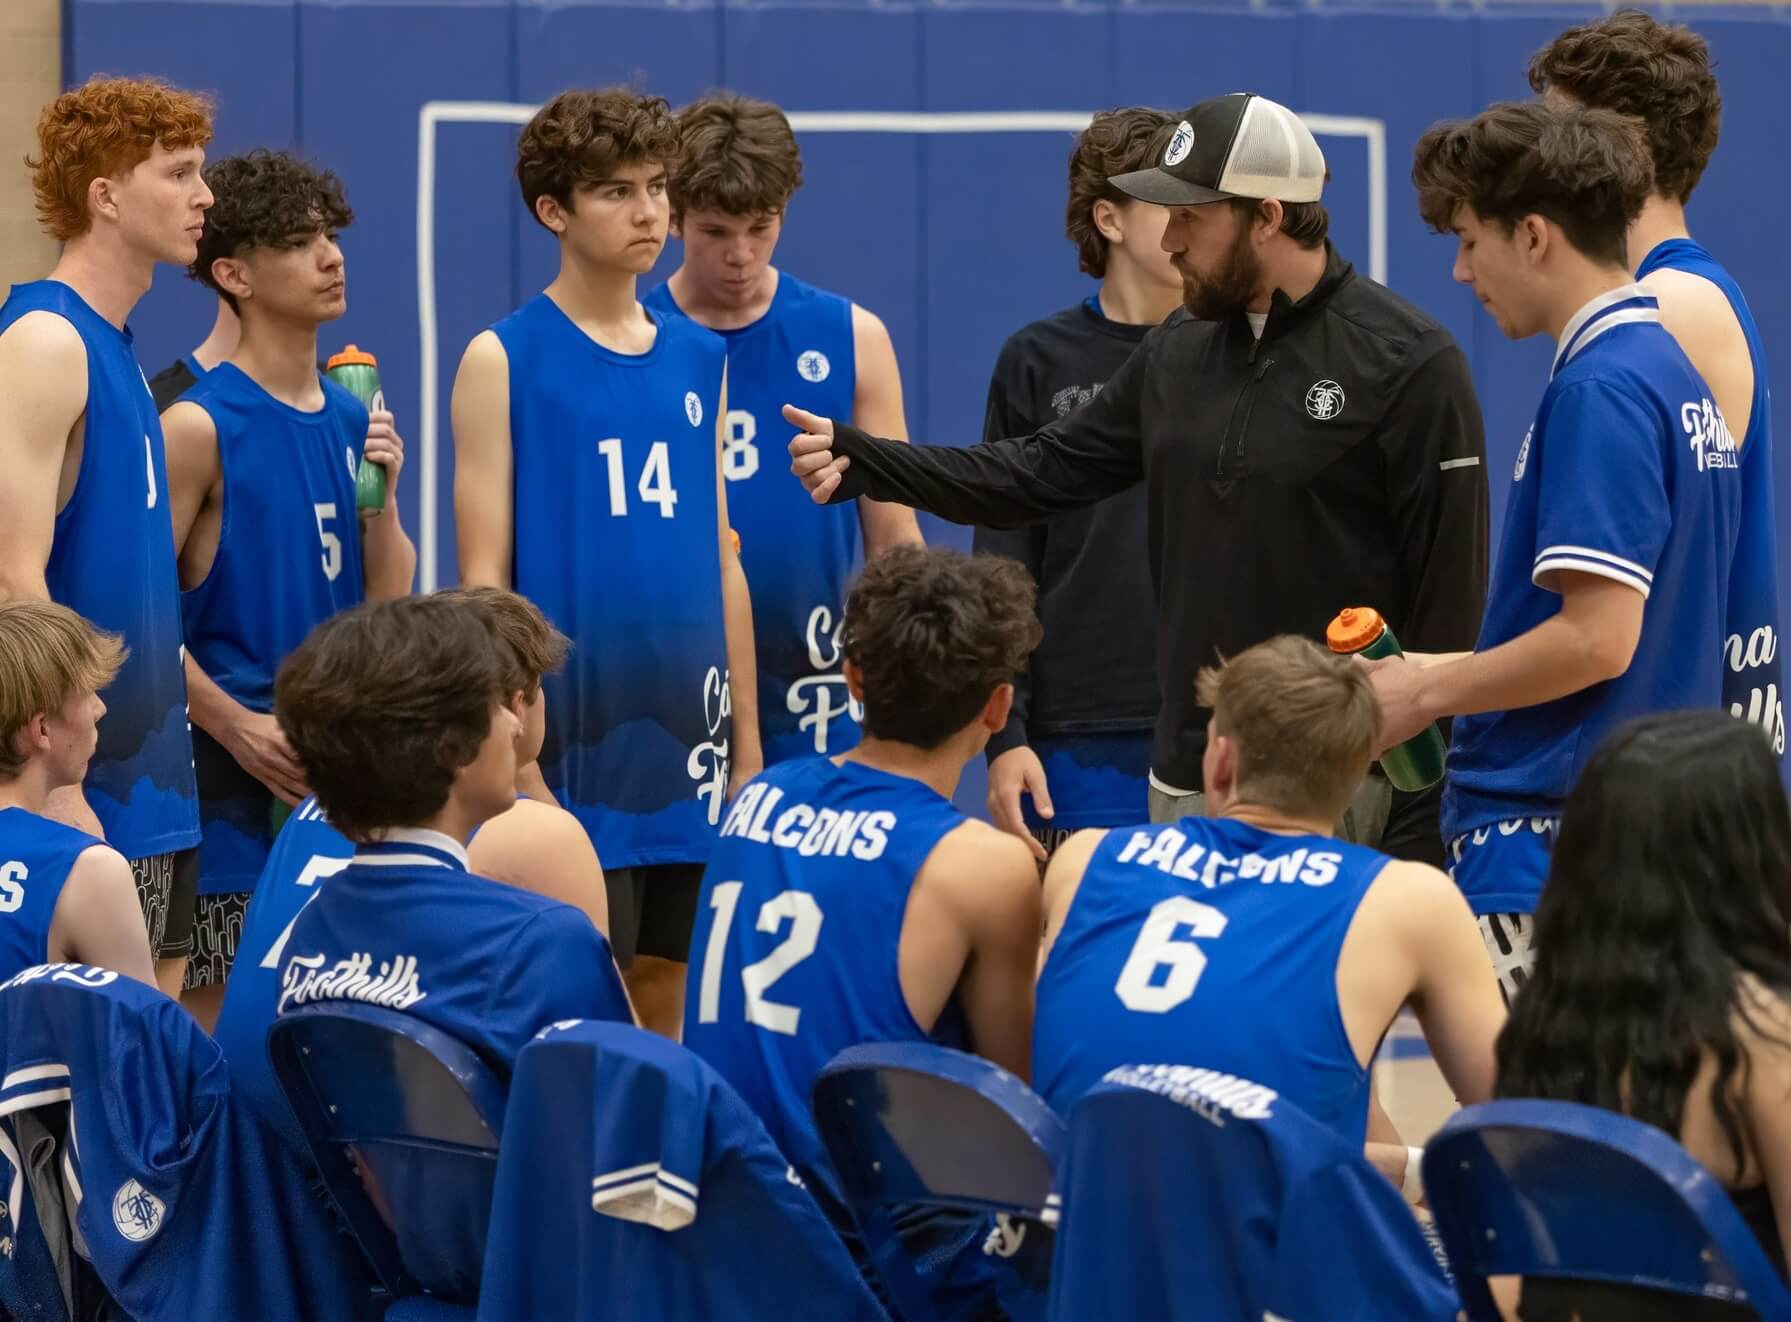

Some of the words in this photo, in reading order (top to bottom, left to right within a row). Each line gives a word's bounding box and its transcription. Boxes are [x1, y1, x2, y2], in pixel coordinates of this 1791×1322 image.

[598, 438, 677, 518] 14
[723, 410, 759, 481] 8
[314, 503, 342, 581] 5
[699, 880, 823, 1037] 12
[1114, 895, 1228, 1013] 6
